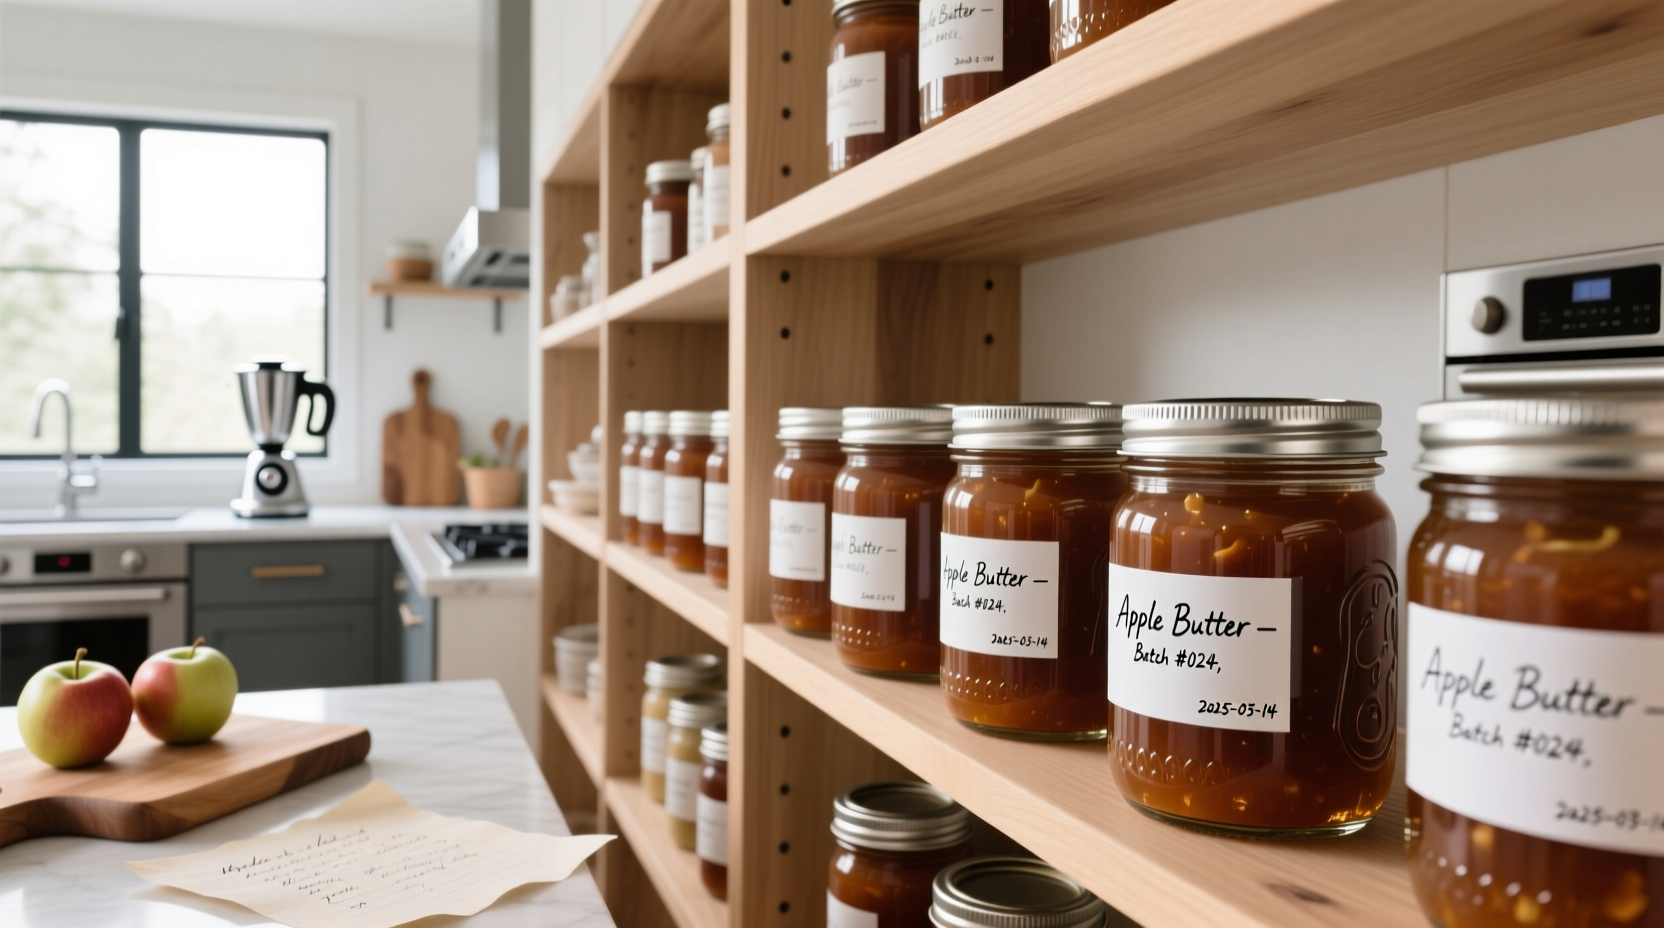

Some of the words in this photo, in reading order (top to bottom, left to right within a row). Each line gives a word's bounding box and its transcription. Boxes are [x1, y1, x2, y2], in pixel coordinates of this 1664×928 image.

[974, 561, 1029, 587] Butter
[1116, 593, 1163, 639] Apple
[1172, 603, 1251, 637] Butter
[1174, 649, 1221, 673] #024,
[1421, 646, 1495, 708] Apple
[1510, 665, 1634, 718] Butter
[1449, 712, 1503, 746] Batch
